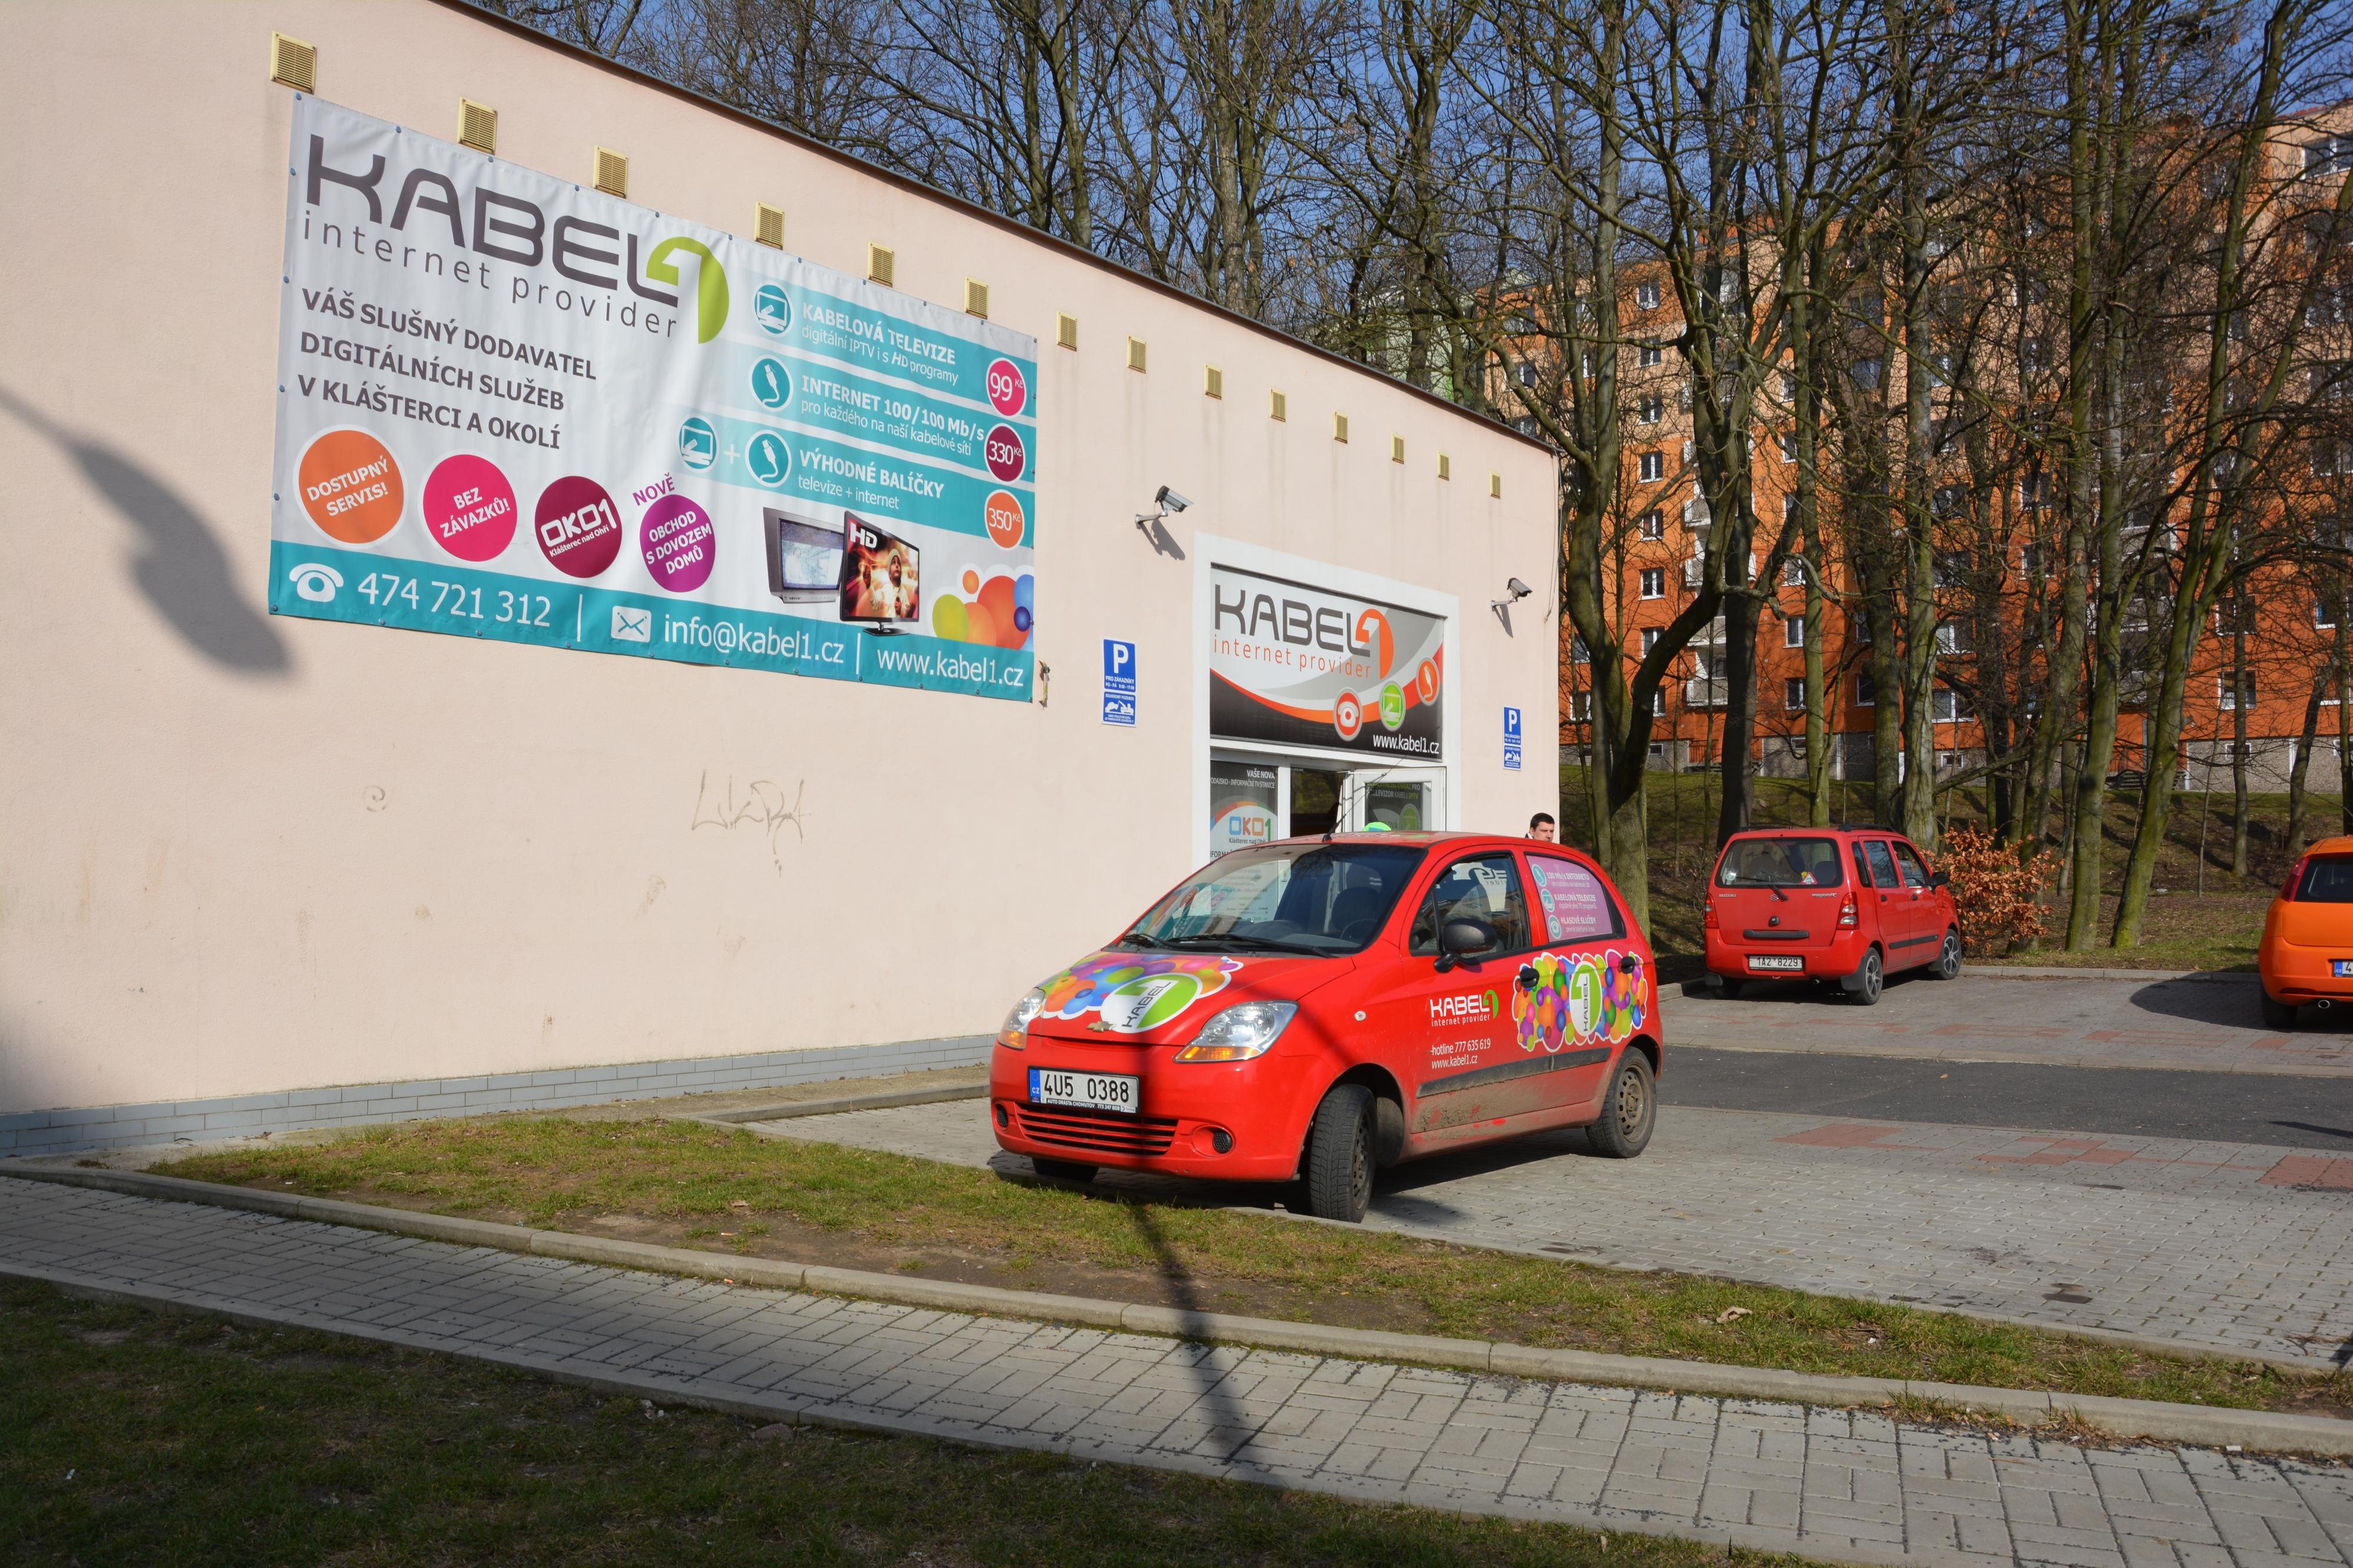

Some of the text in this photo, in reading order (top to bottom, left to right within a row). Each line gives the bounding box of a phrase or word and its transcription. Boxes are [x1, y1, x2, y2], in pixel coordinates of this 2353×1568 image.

[304, 210, 677, 338] internet provider
[302, 287, 597, 381] VÁŠ SLUŠNÝ DODAVATEL
[802, 302, 956, 365] KABELOVÁ TELEVIZE
[301, 331, 565, 411] DIGITÁLNÍCH SLUŽEB
[802, 325, 959, 386] digitální IPTV i s HD programy
[989, 372, 1023, 401] 99 Kč
[297, 373, 561, 450] V KLÁŠTERCI A OKOLÍ
[802, 374, 881, 412] INTERNET
[947, 417, 985, 442] Mb/s
[801, 400, 972, 456] pro každého na naší kabelové síti
[988, 441, 1022, 465] 330 Kč
[306, 455, 389, 502] DOSTUPNÝ
[632, 472, 675, 507] NOVĚ
[799, 448, 945, 499] VÝHODNÉ BALÍČKY
[325, 481, 389, 517] SERVIS!
[453, 487, 483, 510] BEZ
[798, 473, 843, 497] televize
[855, 487, 899, 510] internet
[439, 496, 511, 538] ZÁVAZKŮ!
[541, 498, 617, 548] OKO1
[648, 510, 697, 543] OBCHOD
[988, 508, 1021, 531] 350 Kč
[548, 524, 610, 558] Klášterec nad Ohří
[646, 522, 713, 565] S DOVOZEM
[850, 522, 878, 549] HD
[665, 545, 704, 575] DOMŮ
[357, 571, 1024, 687] 474 721 312 info@kabel1.cz www.kabel1.cz
[1113, 643, 1129, 674] P
[1214, 633, 1371, 678] internet provider
[1114, 676, 1135, 684] ZÁKAZNÍKY
[1508, 709, 1518, 732] P
[1373, 734, 1440, 755] www.kabel1.cz
[1247, 768, 1260, 778] VAŠE
[1229, 816, 1271, 842] OKO1
[1757, 957, 1798, 968] 1A2 8229
[1431, 1013, 1491, 1027] internet provider
[1432, 1038, 1491, 1056] hotline 777 635 619
[1432, 1053, 1478, 1069] www.kabel1.cz
[1032, 1073, 1129, 1103] CZ 4U5 0388
[1072, 1100, 1095, 1109] CHOMUTOV
